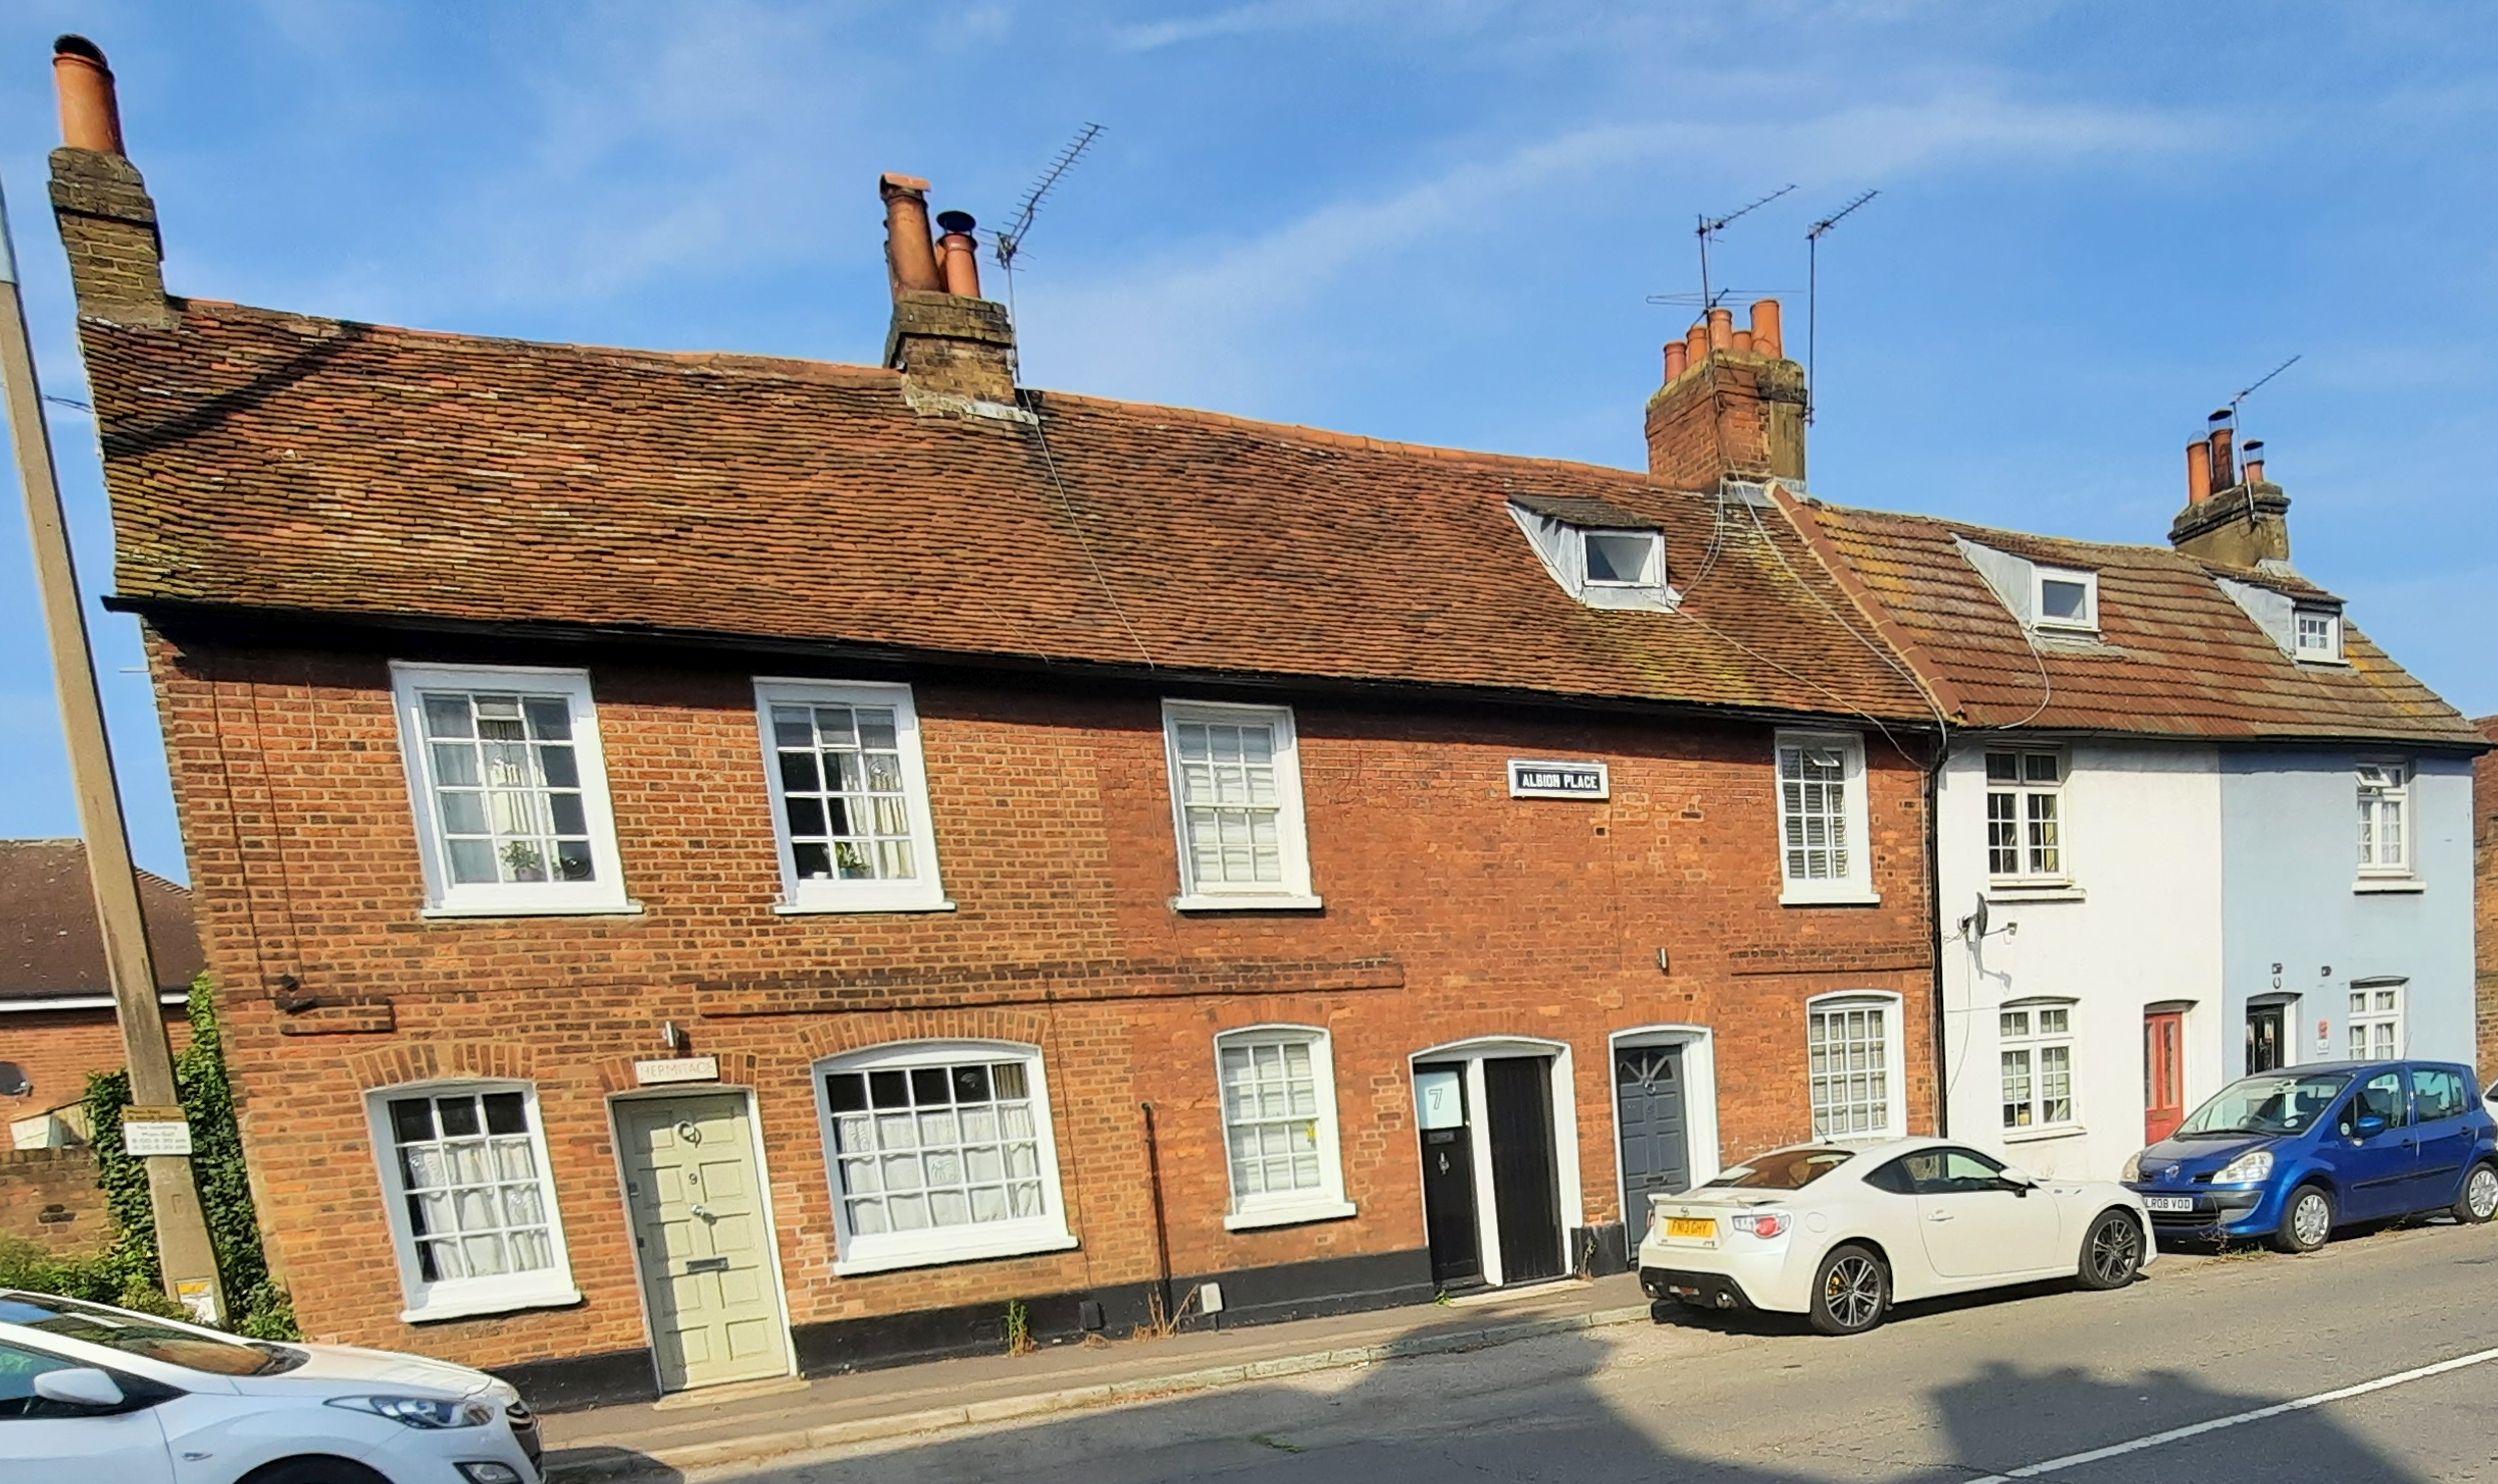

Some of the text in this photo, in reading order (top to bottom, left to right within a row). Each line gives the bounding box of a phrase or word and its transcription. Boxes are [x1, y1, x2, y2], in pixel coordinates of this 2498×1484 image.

[1522, 773, 1598, 789] ALBION PLACE
[1428, 1088, 1443, 1110] 7
[688, 1173, 698, 1185] 9
[2145, 1198, 2169, 1208] LR08
